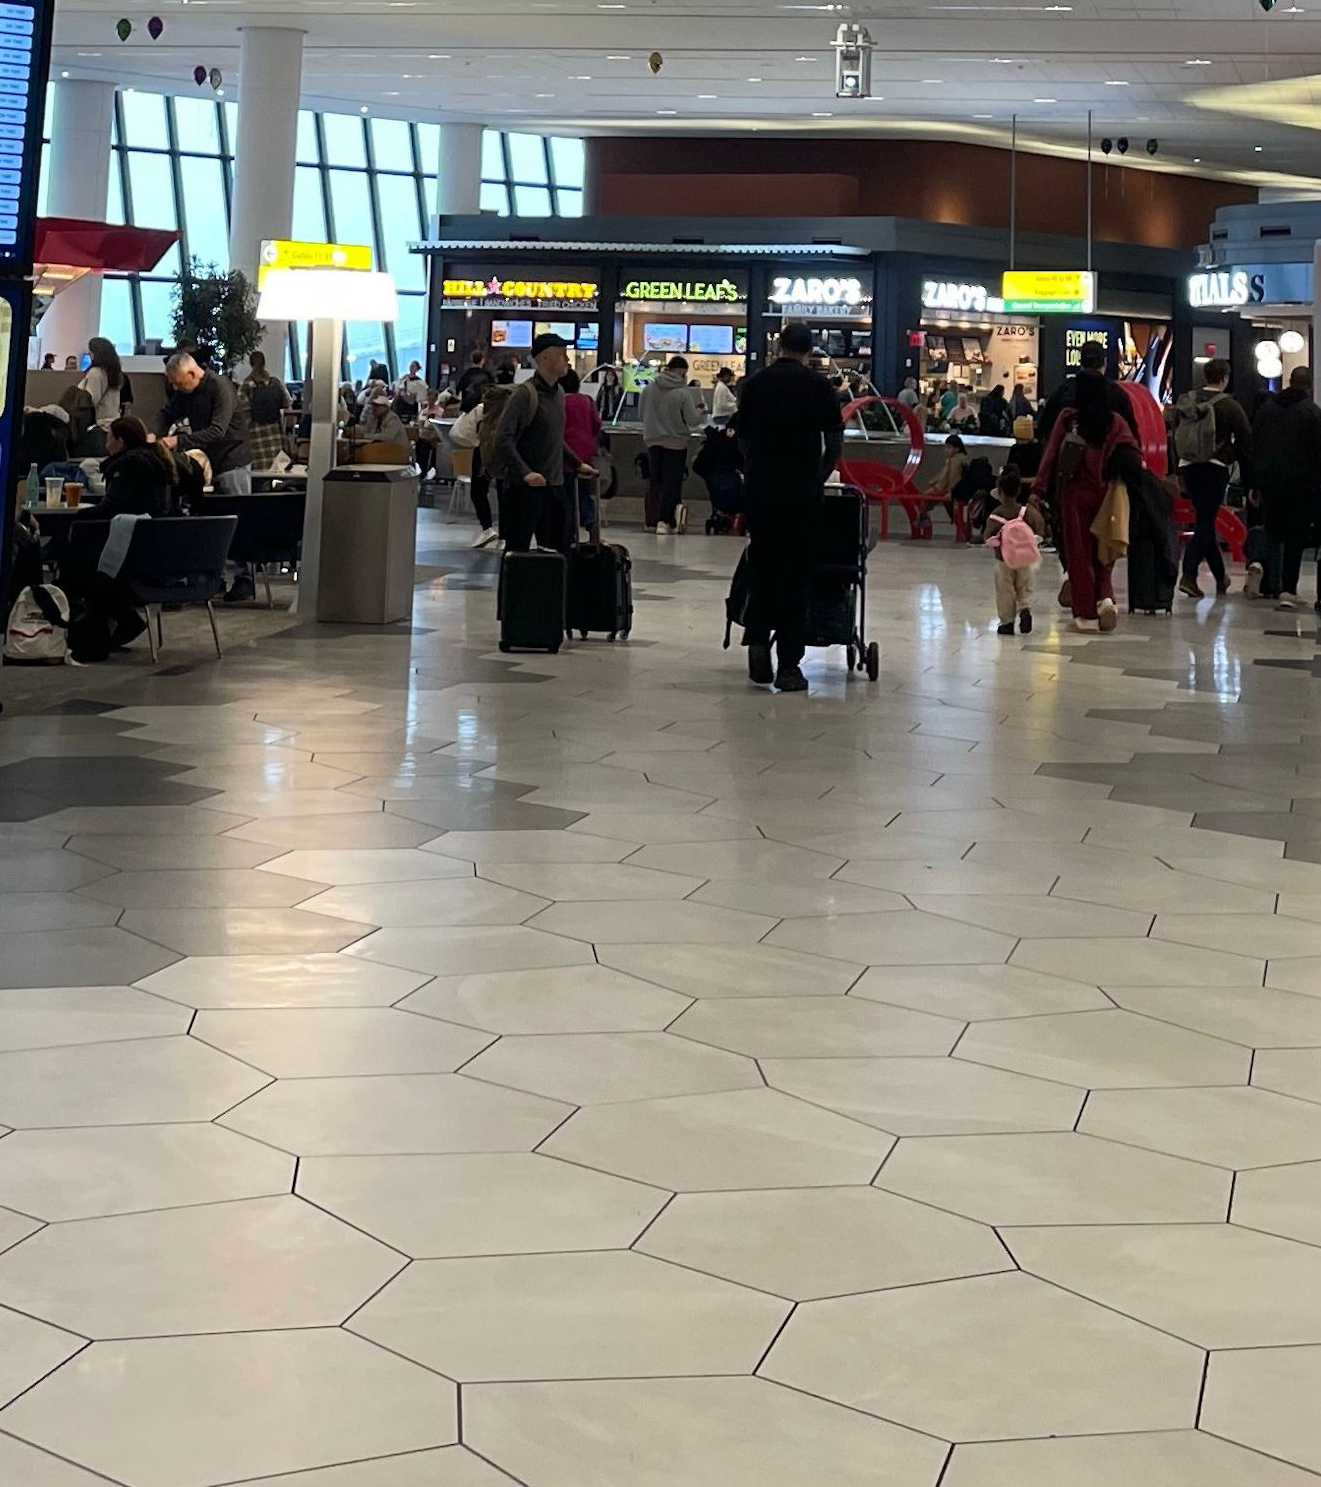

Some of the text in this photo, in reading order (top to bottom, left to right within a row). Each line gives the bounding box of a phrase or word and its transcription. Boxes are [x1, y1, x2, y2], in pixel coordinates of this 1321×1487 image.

[443, 280, 597, 299] HILL COUNTRY
[626, 280, 738, 301] GREEN LEAF'S
[773, 277, 861, 305] ZARO'S
[923, 280, 987, 312] ZARO'S
[816, 304, 852, 315] BAKERY
[997, 325, 1035, 337] ZARO'S
[1066, 330, 1086, 347] EVEN
